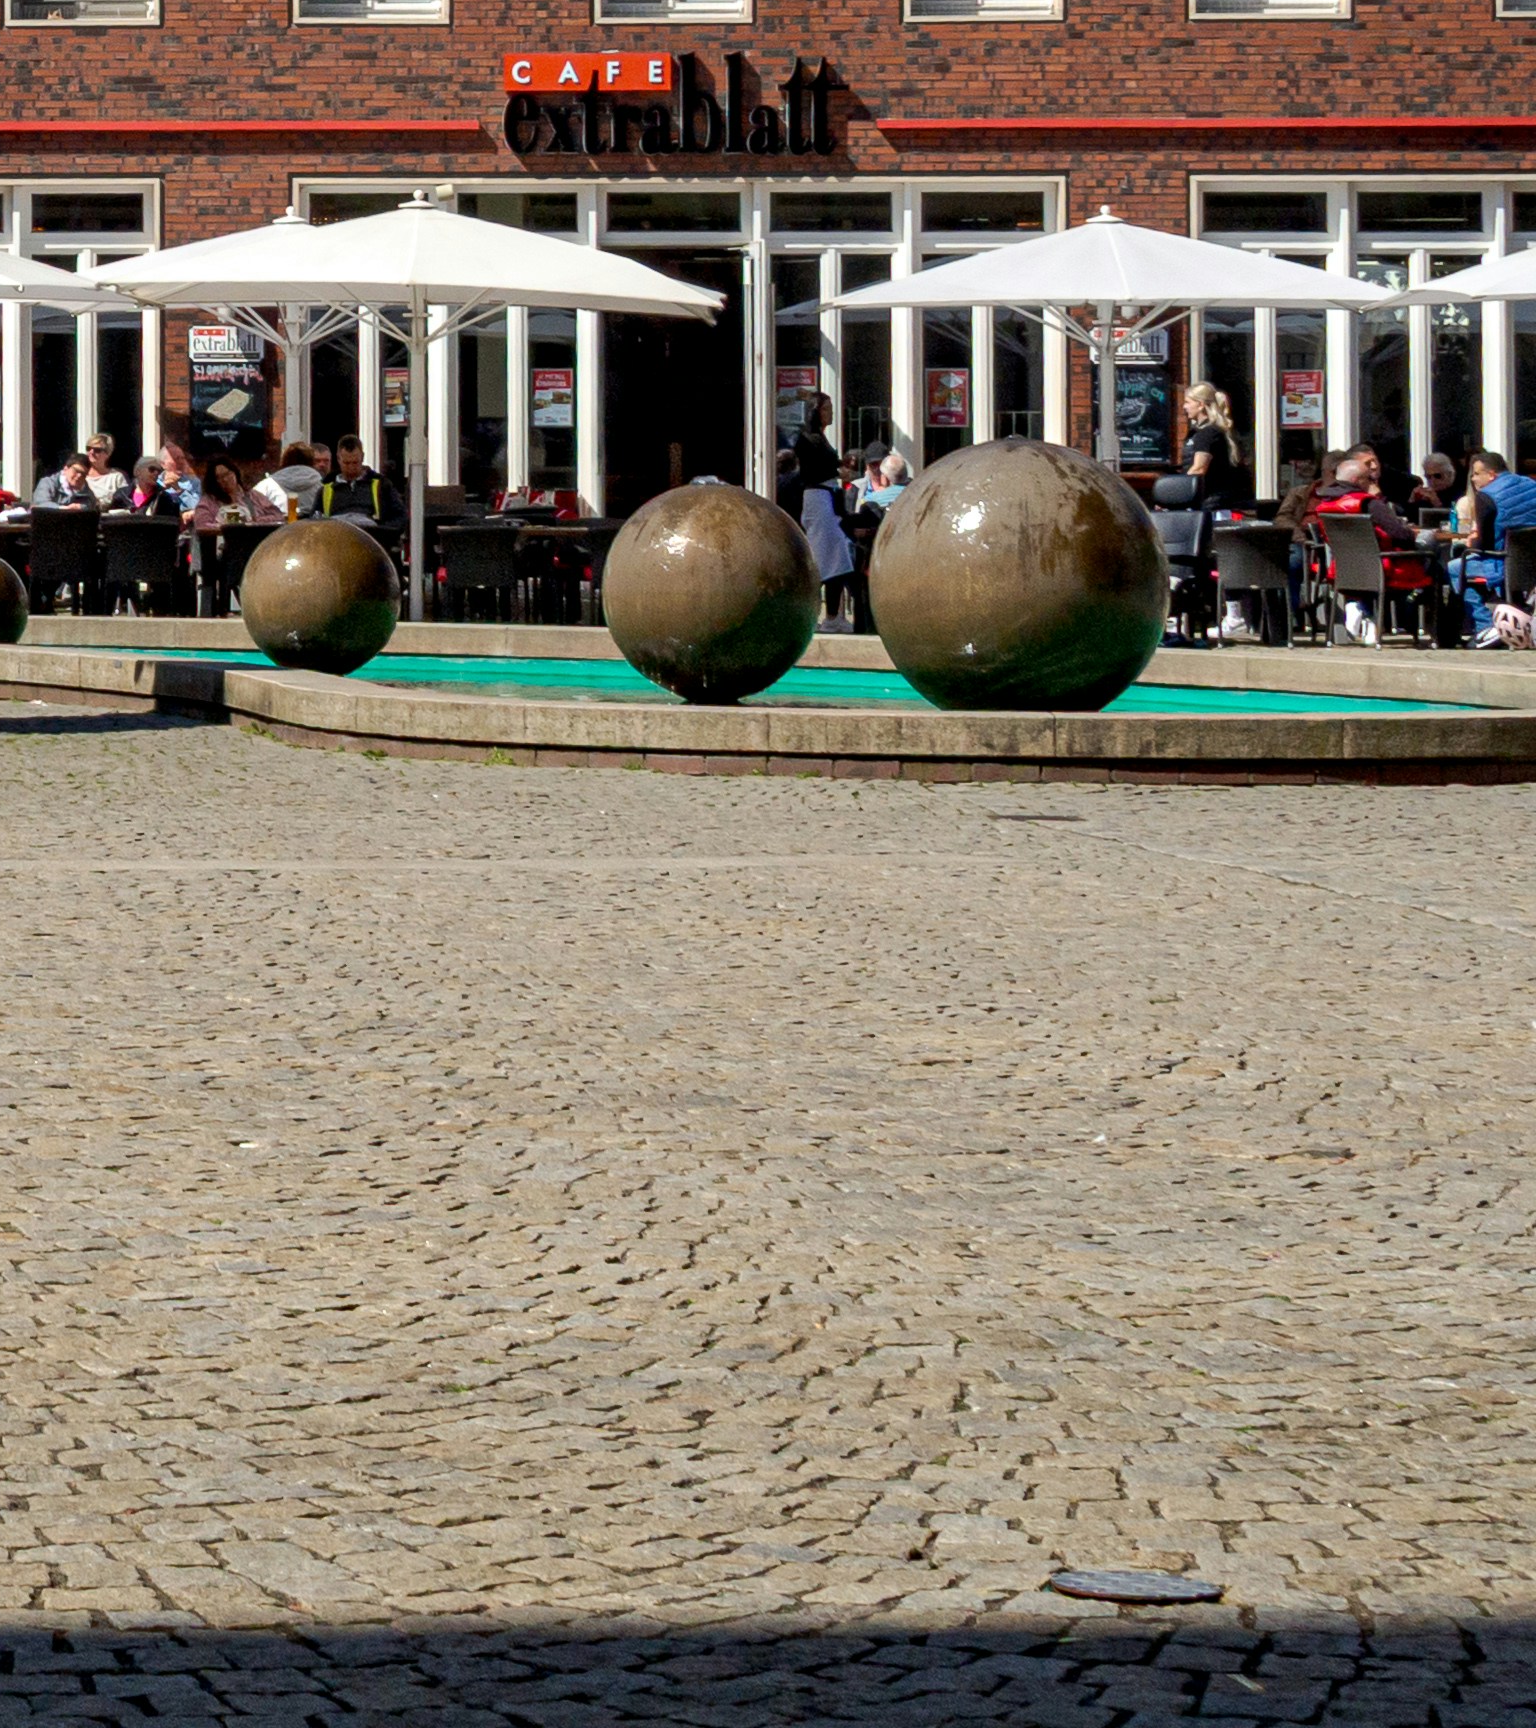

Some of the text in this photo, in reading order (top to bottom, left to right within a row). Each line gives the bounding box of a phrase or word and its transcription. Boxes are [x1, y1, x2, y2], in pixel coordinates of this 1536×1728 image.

[511, 60, 665, 85] CAFE
[503, 50, 850, 156] extrablatt
[193, 330, 257, 352] extrablatt
